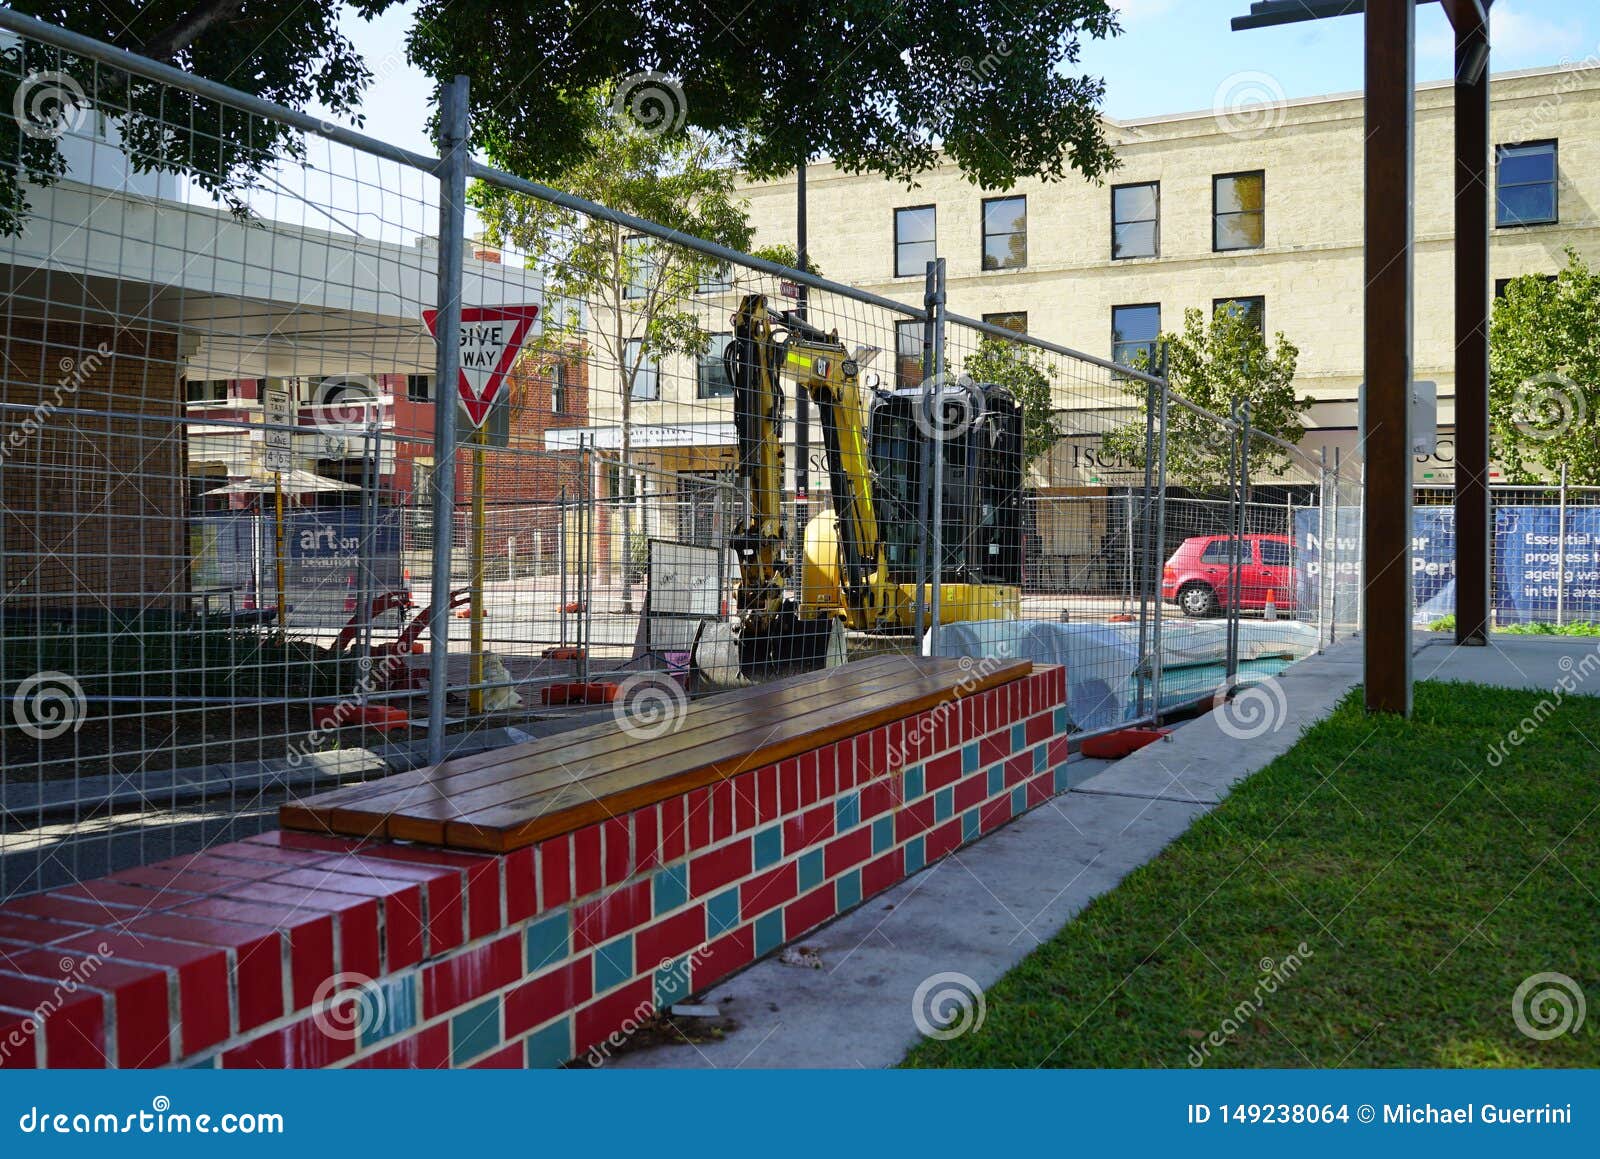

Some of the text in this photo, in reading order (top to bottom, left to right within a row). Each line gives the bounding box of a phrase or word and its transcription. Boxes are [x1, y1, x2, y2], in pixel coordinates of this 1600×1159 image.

[459, 327, 503, 347] GIVE
[463, 351, 496, 367] WAY
[300, 525, 360, 550] art on
[1307, 532, 1357, 551] New
[1525, 551, 1590, 565] progess
[1524, 584, 1539, 597] in
[1542, 585, 1569, 597] ths
